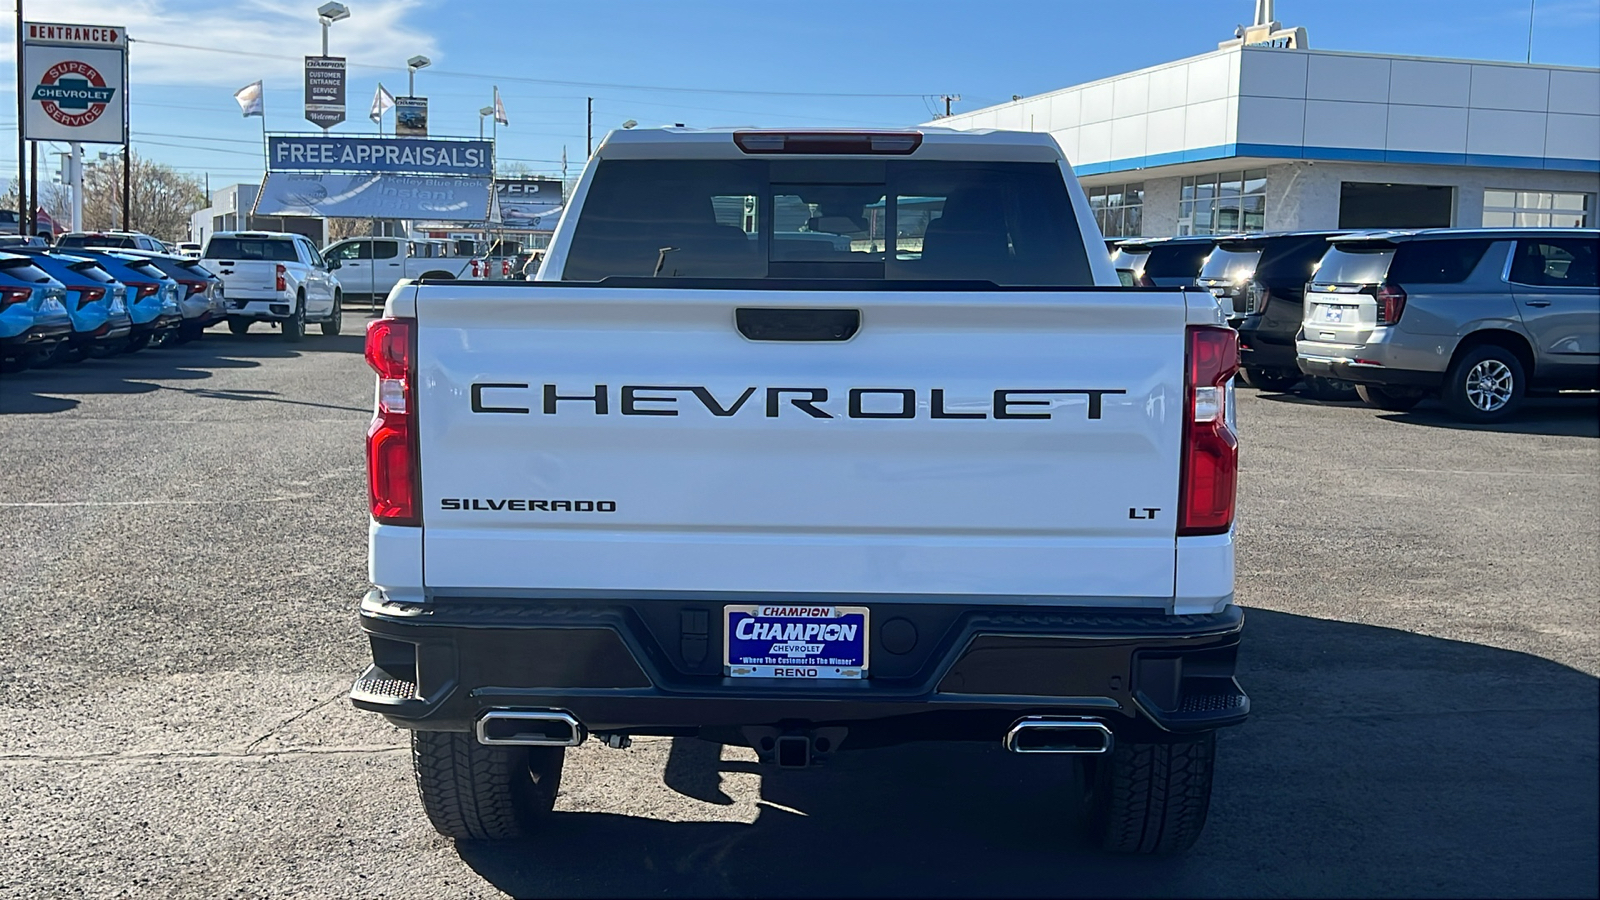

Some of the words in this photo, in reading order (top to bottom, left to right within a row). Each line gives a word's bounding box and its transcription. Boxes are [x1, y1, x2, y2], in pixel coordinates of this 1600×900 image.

[39, 26, 108, 42] ENTRANCE
[49, 62, 97, 79] SUPER
[37, 88, 109, 99] CHEVROLET
[46, 103, 101, 126] SERVICE
[277, 143, 334, 163] FREE
[341, 145, 484, 168] APPRAISALS!
[388, 176, 422, 186] Kelley
[426, 178, 451, 186] Blue
[454, 179, 483, 187] Book
[380, 184, 454, 200] Instant
[471, 383, 1127, 419] CHEVROLET
[441, 498, 616, 512] SILVERADO
[1129, 508, 1161, 519] LT
[763, 606, 830, 617] CHAMPION
[735, 618, 857, 641] CHAMPION
[809, 657, 816, 665] Is
[817, 657, 828, 665] The
[774, 668, 818, 677] RENO
